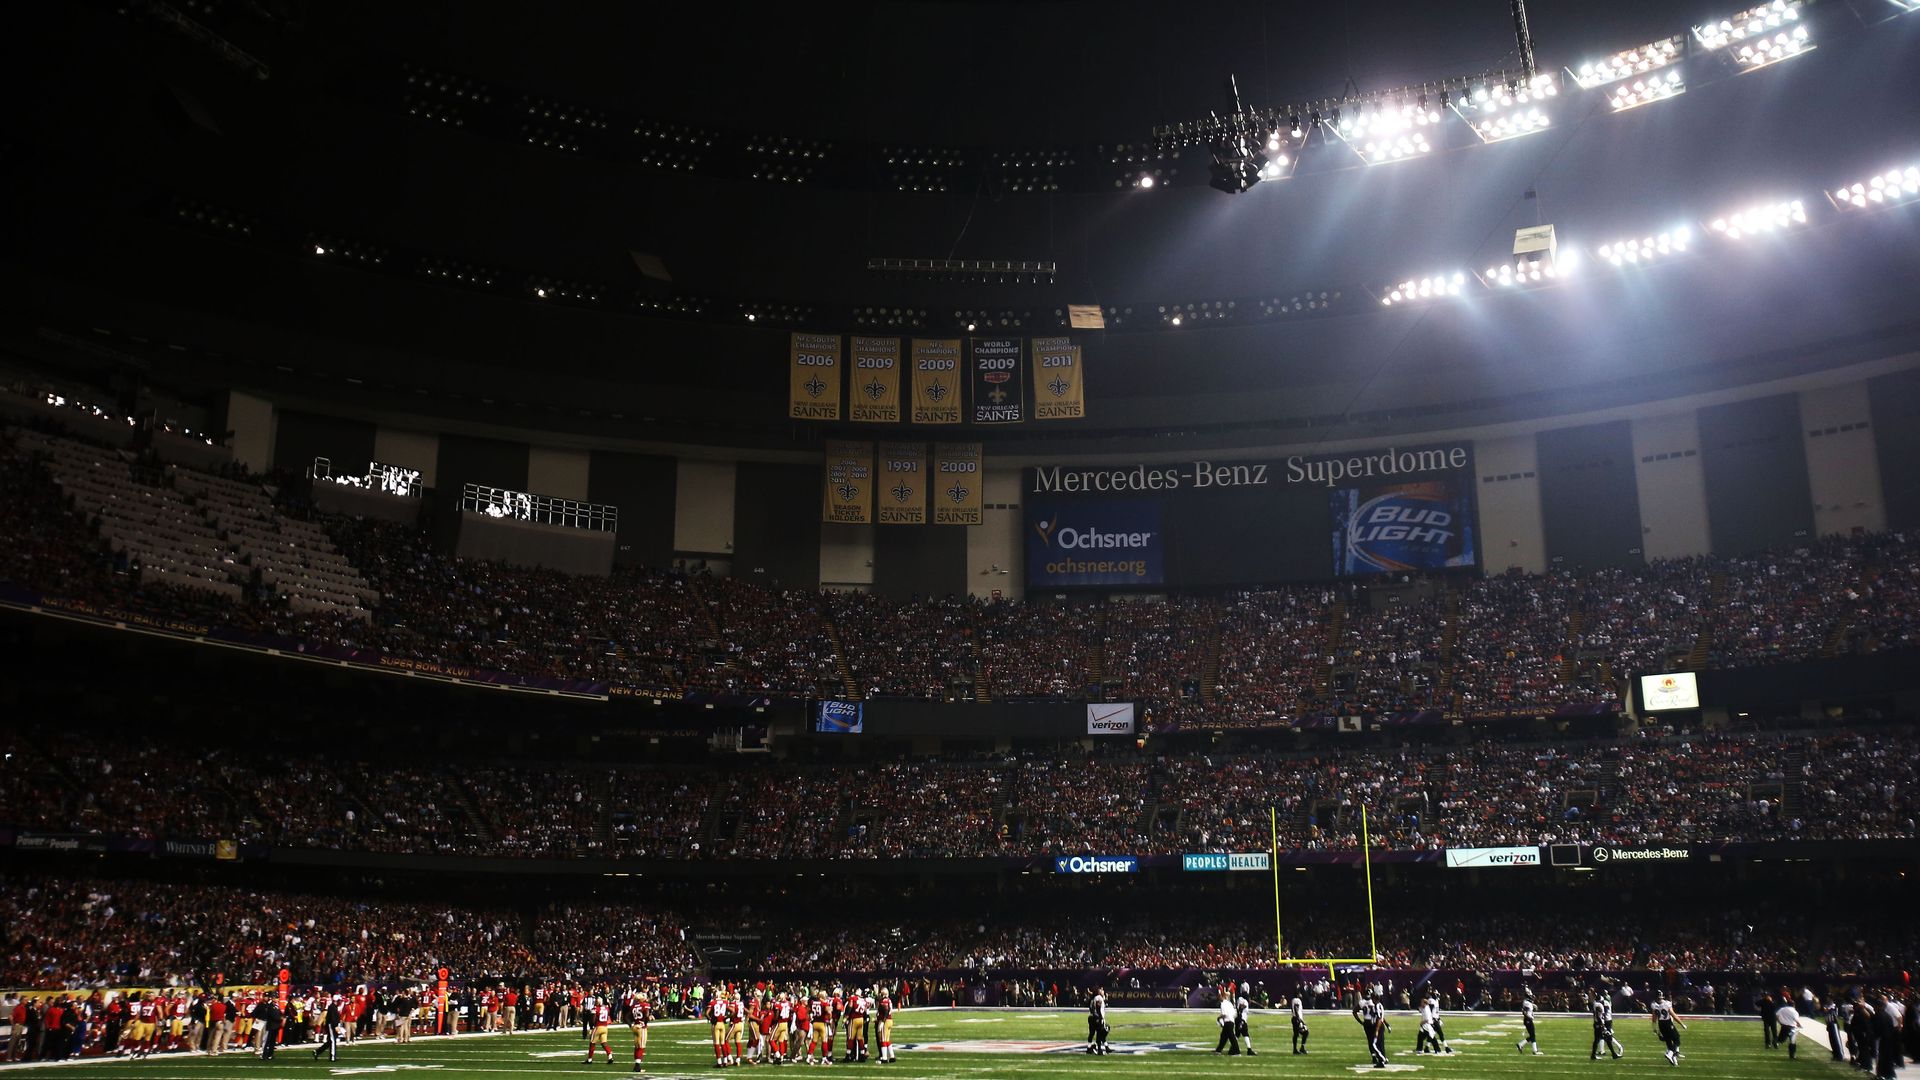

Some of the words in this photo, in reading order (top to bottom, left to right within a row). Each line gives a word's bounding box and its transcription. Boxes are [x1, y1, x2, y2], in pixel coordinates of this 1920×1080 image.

[974, 346, 1019, 354] CHAMPIONS
[797, 353, 834, 366] 2006
[857, 357, 894, 369] 2009
[918, 358, 955, 370] 2009
[978, 358, 1016, 370] 2009
[1042, 355, 1073, 367] 2011
[793, 407, 836, 418] SAINTS
[853, 409, 896, 421] SAINTS
[915, 411, 958, 422] SAINTS
[976, 410, 1019, 421] SAINTS
[1038, 406, 1081, 417] SAINTS
[887, 461, 917, 472] 1991
[940, 461, 977, 473] 2000
[1032, 460, 1268, 493] Mercedes-Benz
[1286, 447, 1467, 487] Superdome
[880, 512, 922, 521] SAINTS
[937, 512, 978, 522] SAINTS
[1368, 505, 1452, 527] BUD
[1057, 527, 1151, 549] Ochsner
[1353, 525, 1455, 545] LIGHT
[1046, 557, 1147, 577] ochsner.org
[41, 598, 98, 615] NATIONAL
[103, 609, 162, 627] FOOTBALL
[164, 619, 209, 634] LEAGUE
[380, 656, 414, 669] SUPER
[415, 661, 443, 673] BOWL
[446, 665, 470, 677] XLVII
[608, 686, 632, 696] NEW
[634, 688, 684, 699] ORLEANS
[825, 708, 857, 716] LIGHT
[830, 701, 856, 711] BUD
[1442, 708, 1507, 720] BALTIMORE
[1510, 706, 1556, 717] RAVENS
[1092, 721, 1129, 731] verizon
[1179, 722, 1200, 730] SAN
[1202, 720, 1258, 730] FRANCISCO
[49, 838, 80, 852] People
[165, 840, 206, 856] WHITNEY
[1488, 852, 1537, 865] verizon
[1611, 848, 1689, 861] Mercedes-Benz
[1069, 856, 1132, 873] Ochsner
[1185, 856, 1227, 869] PEOPLES
[1231, 854, 1267, 868] HEALTH
[1126, 990, 1152, 999] BOWL
[713, 1003, 727, 1017] 84
[811, 1003, 822, 1017] 59
